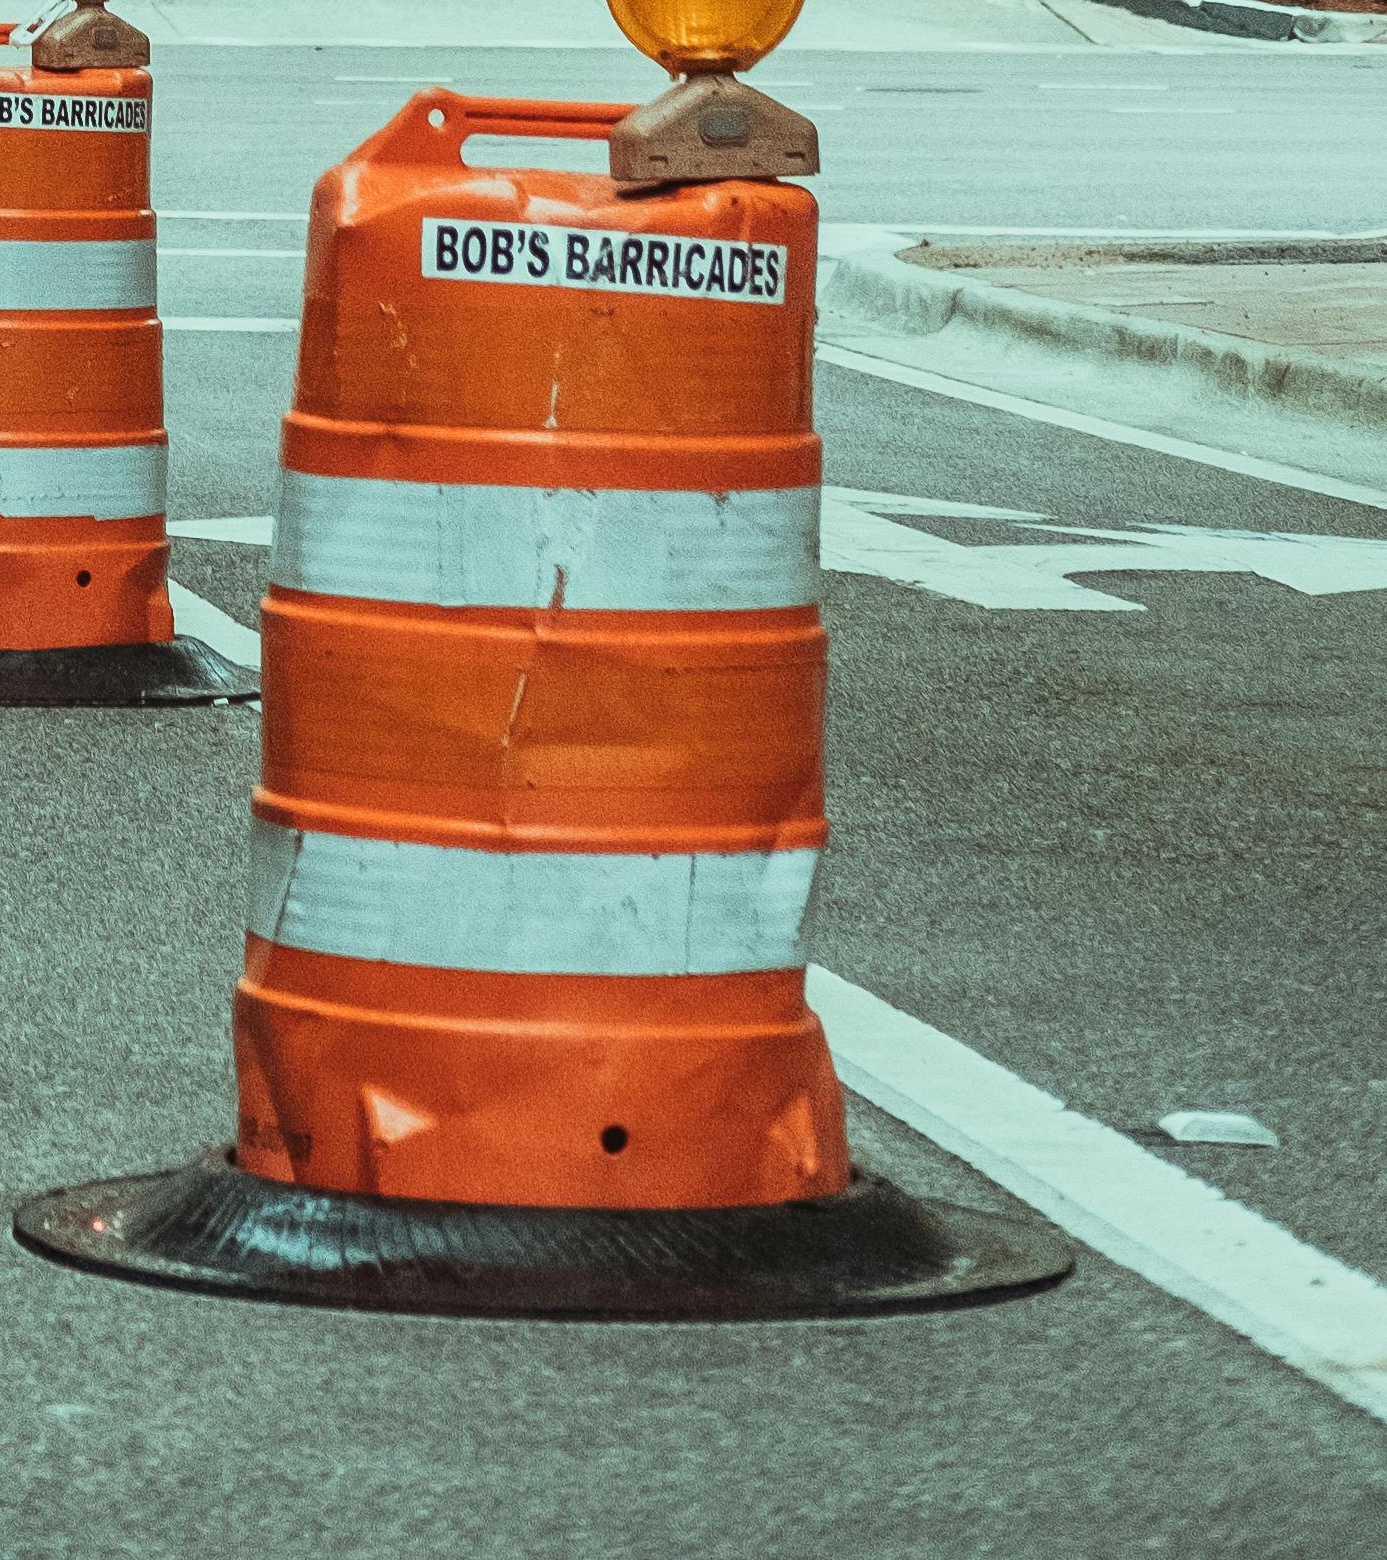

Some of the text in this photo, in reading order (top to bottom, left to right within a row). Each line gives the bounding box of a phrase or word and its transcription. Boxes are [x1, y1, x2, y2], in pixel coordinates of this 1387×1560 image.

[41, 98, 146, 130] BARRICADES
[436, 225, 779, 297] BOB'S BARRICADES
